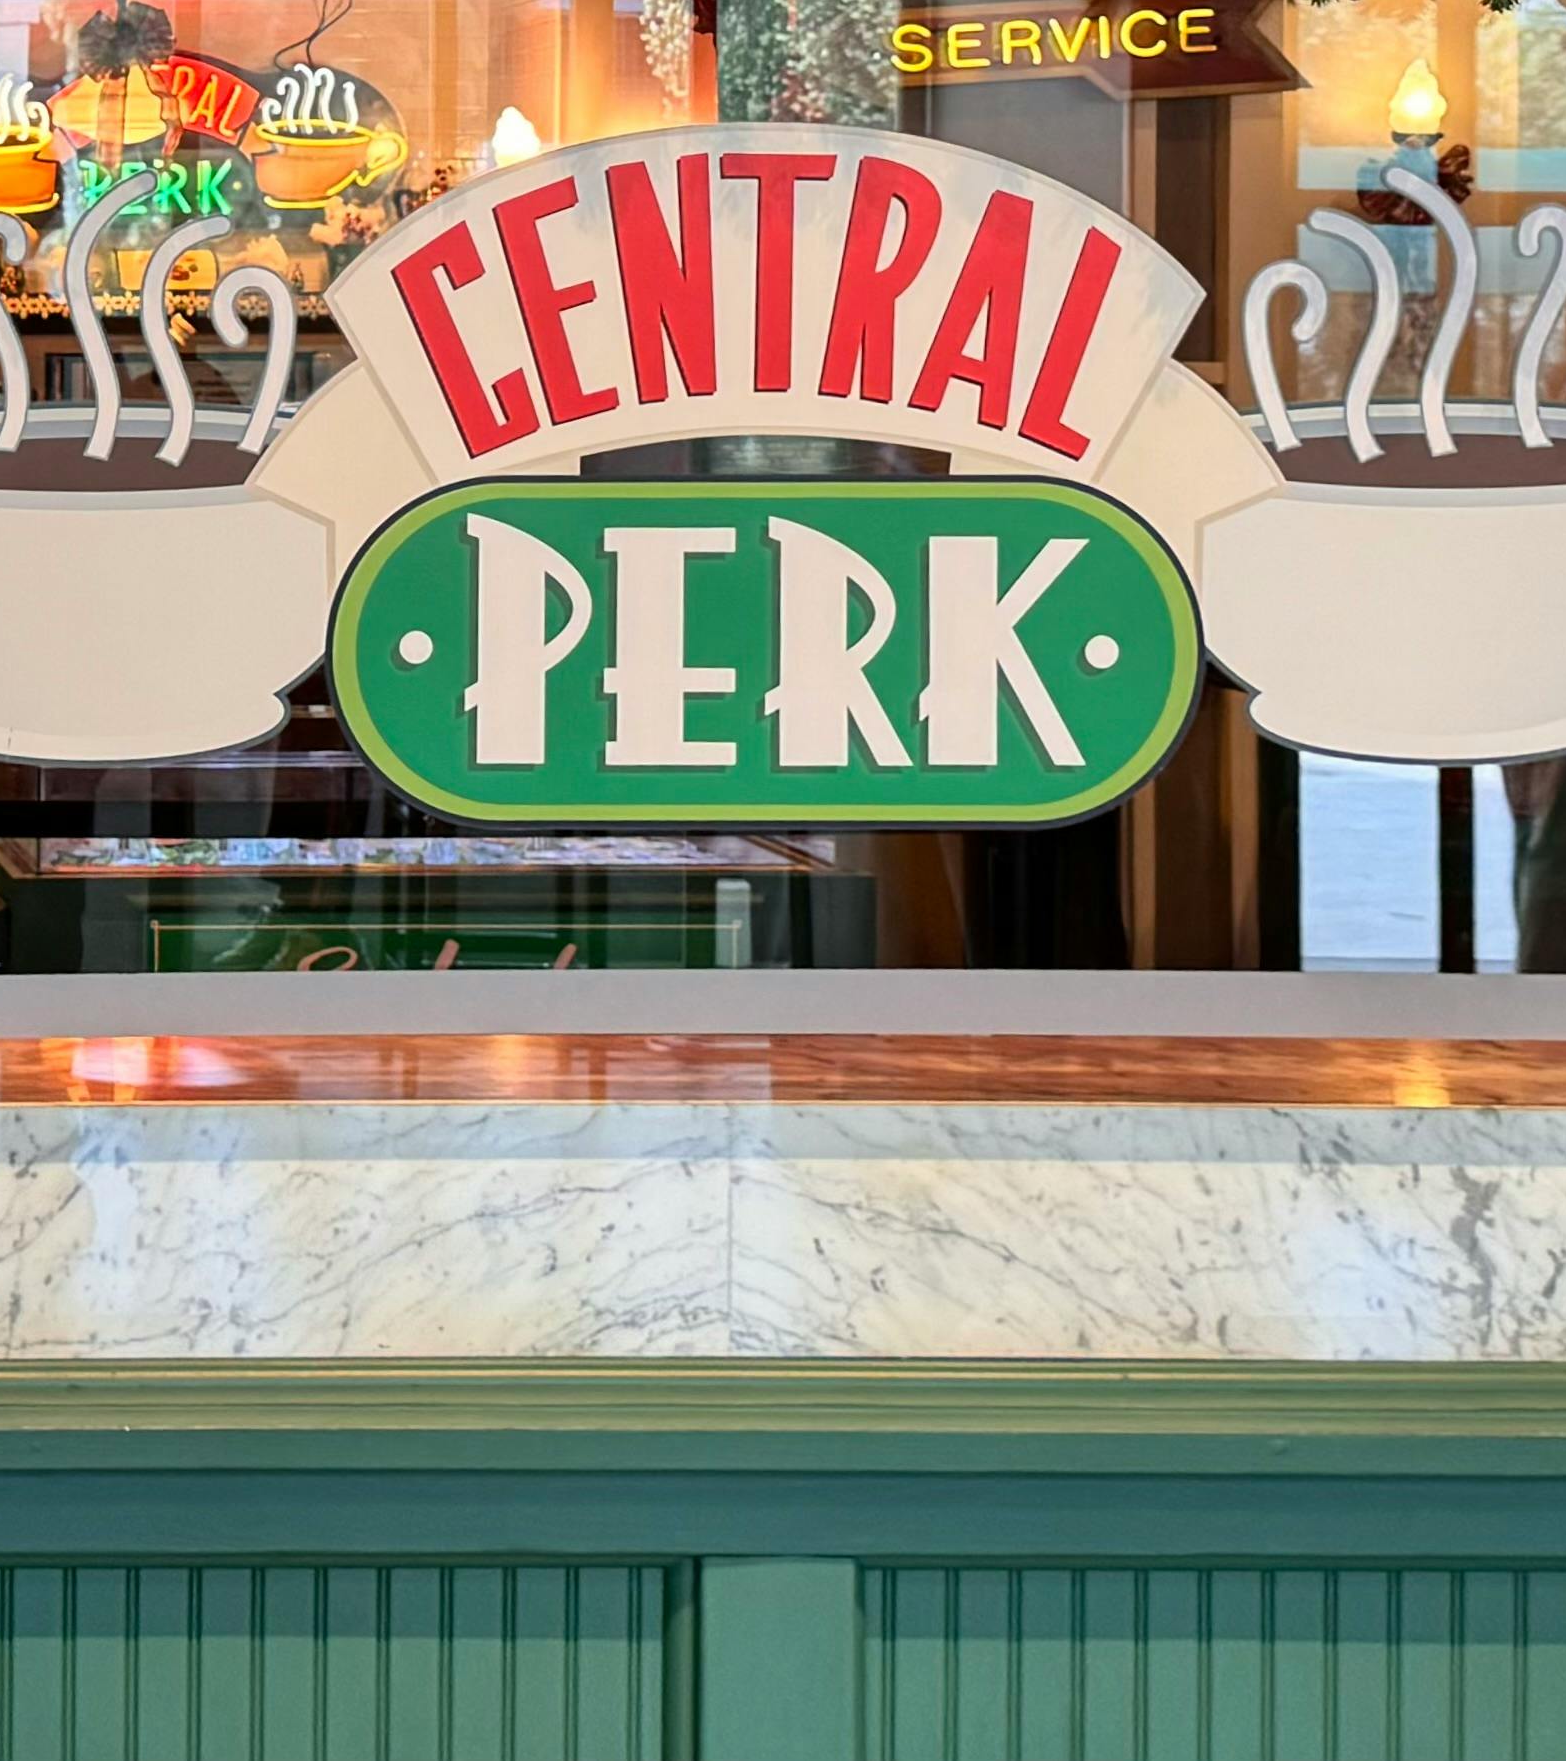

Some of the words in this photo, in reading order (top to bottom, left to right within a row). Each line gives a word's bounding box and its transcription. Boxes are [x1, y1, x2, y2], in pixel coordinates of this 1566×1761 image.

[890, 7, 1218, 73] SERVICE
[390, 153, 1122, 461] CENTRAL
[463, 512, 1090, 767] PERK
